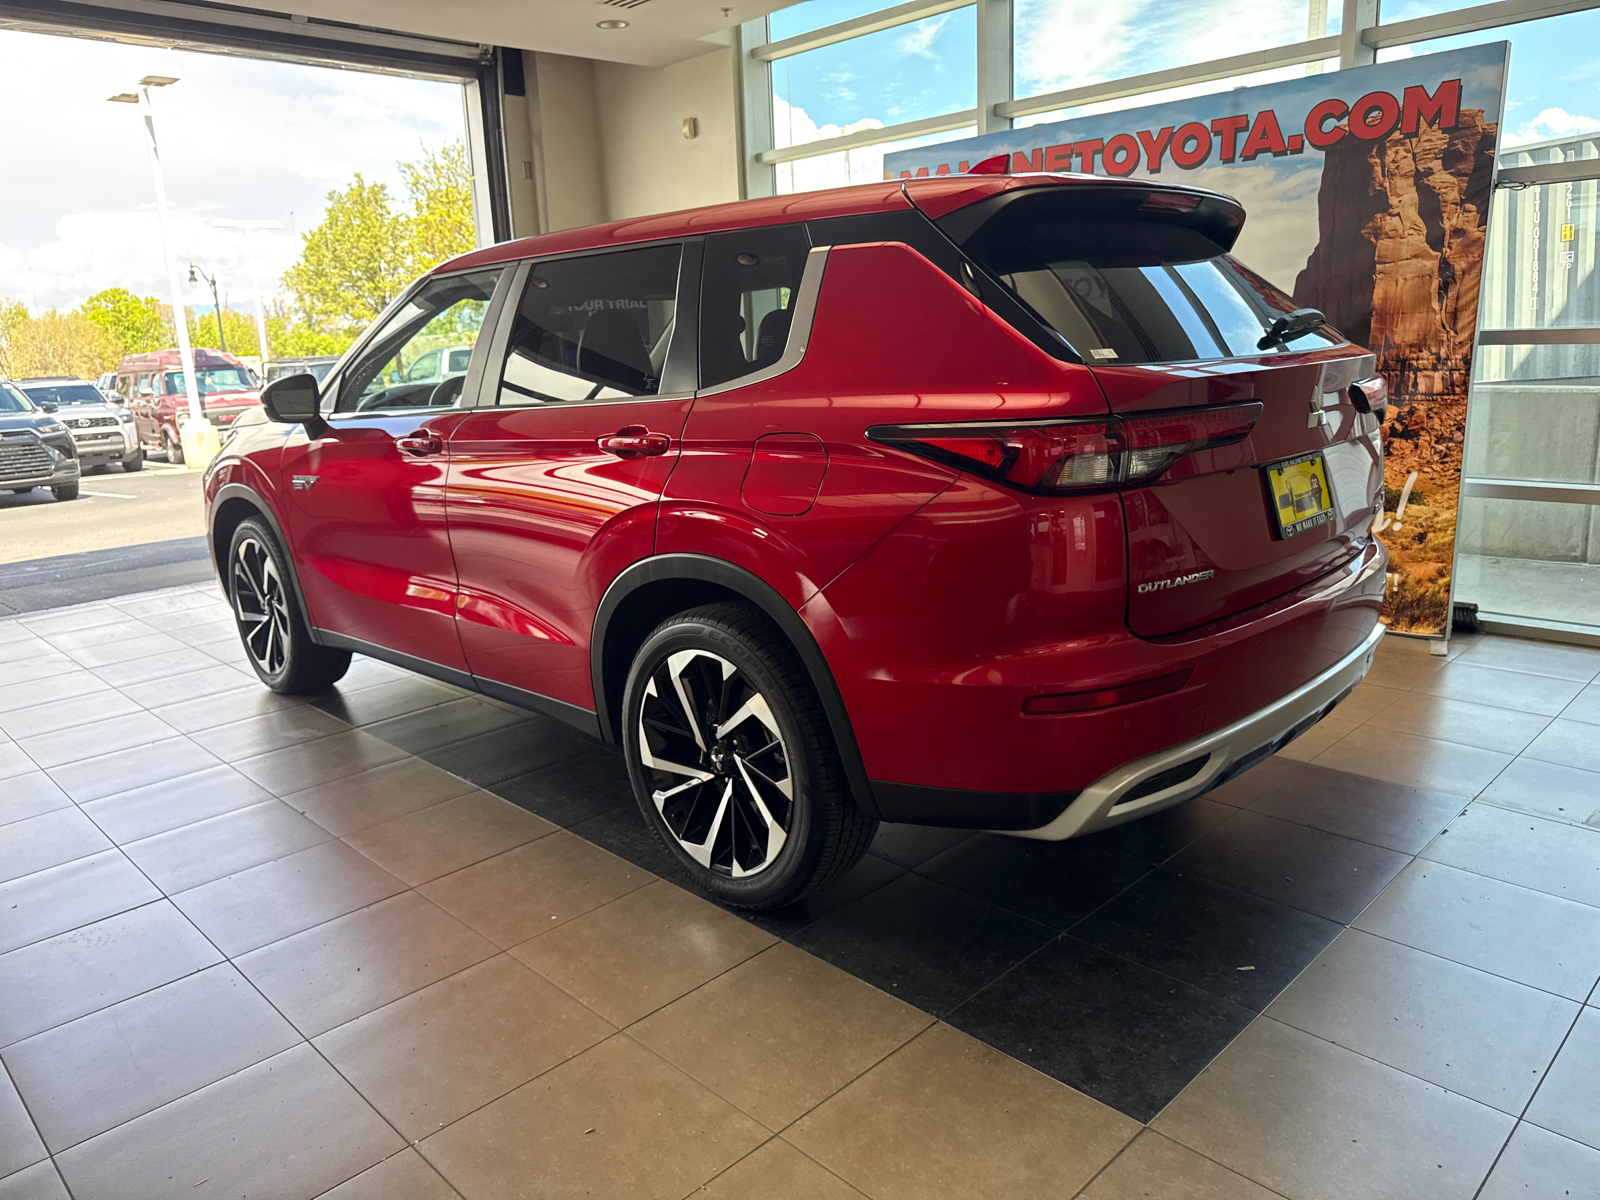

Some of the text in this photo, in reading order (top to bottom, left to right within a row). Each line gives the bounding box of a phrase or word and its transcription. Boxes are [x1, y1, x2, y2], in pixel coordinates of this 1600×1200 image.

[900, 78, 1463, 179] NETOYOTA.COM
[606, 299, 647, 310] TRIAL
[1137, 569, 1215, 593] OUTLANDER
